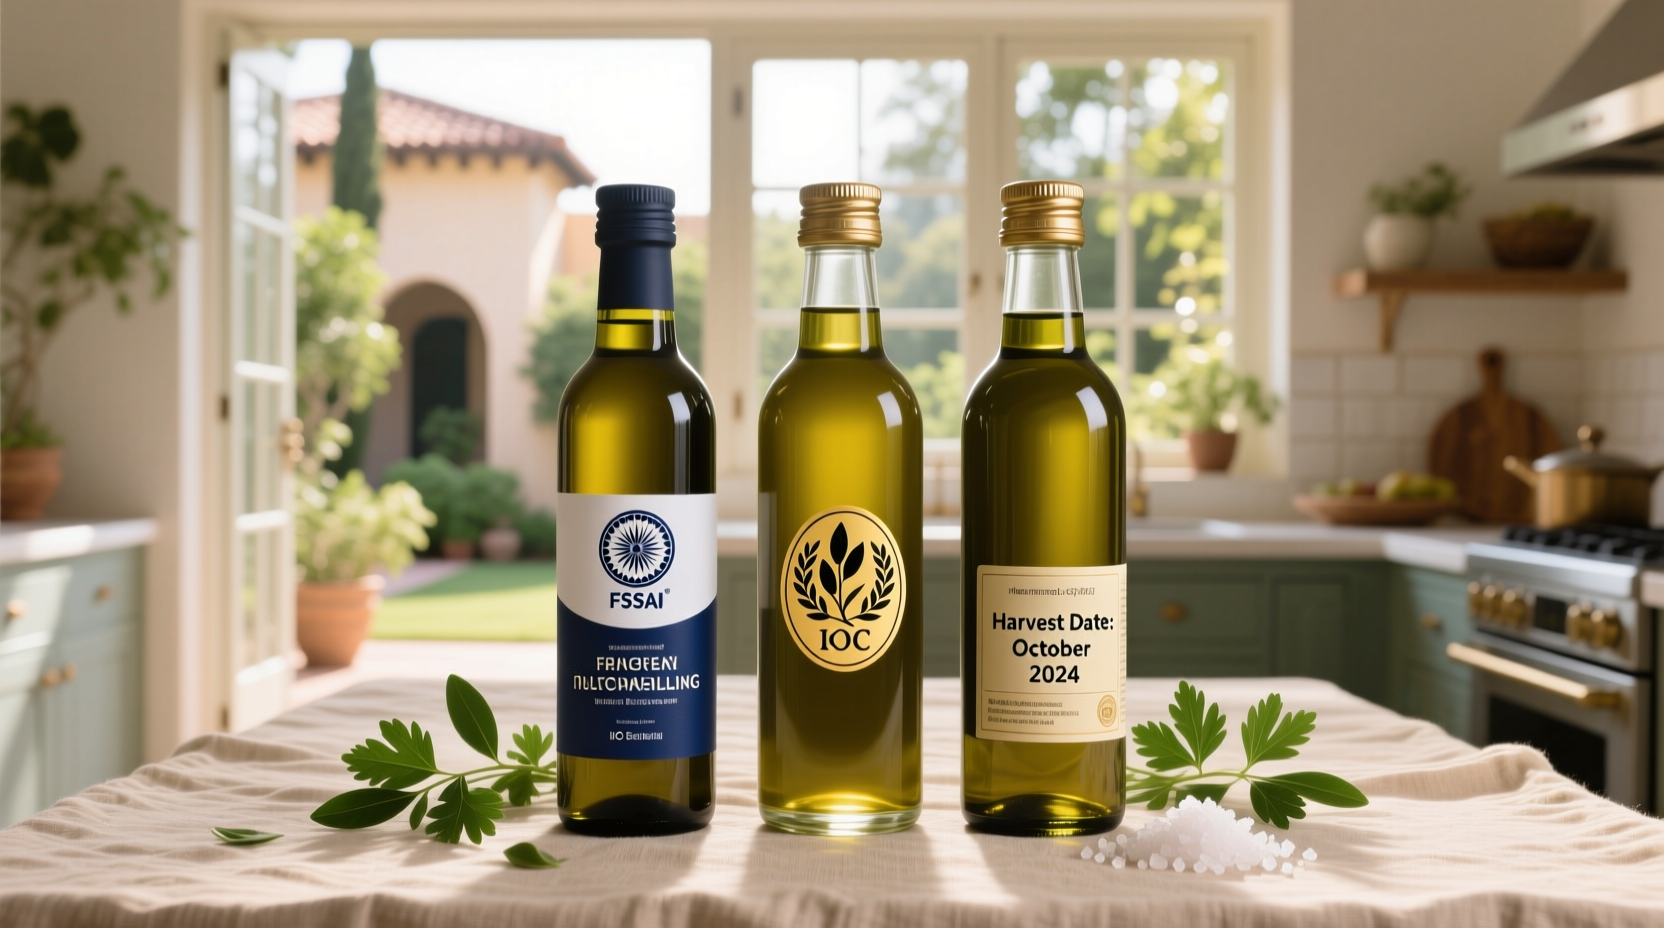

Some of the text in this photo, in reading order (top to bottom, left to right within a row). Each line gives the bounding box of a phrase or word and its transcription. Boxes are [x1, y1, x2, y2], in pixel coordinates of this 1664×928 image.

[992, 612, 1114, 631] Harvest Date:
[819, 628, 871, 651] IOC
[1012, 638, 1091, 657] October
[1029, 665, 1080, 684] 2024
